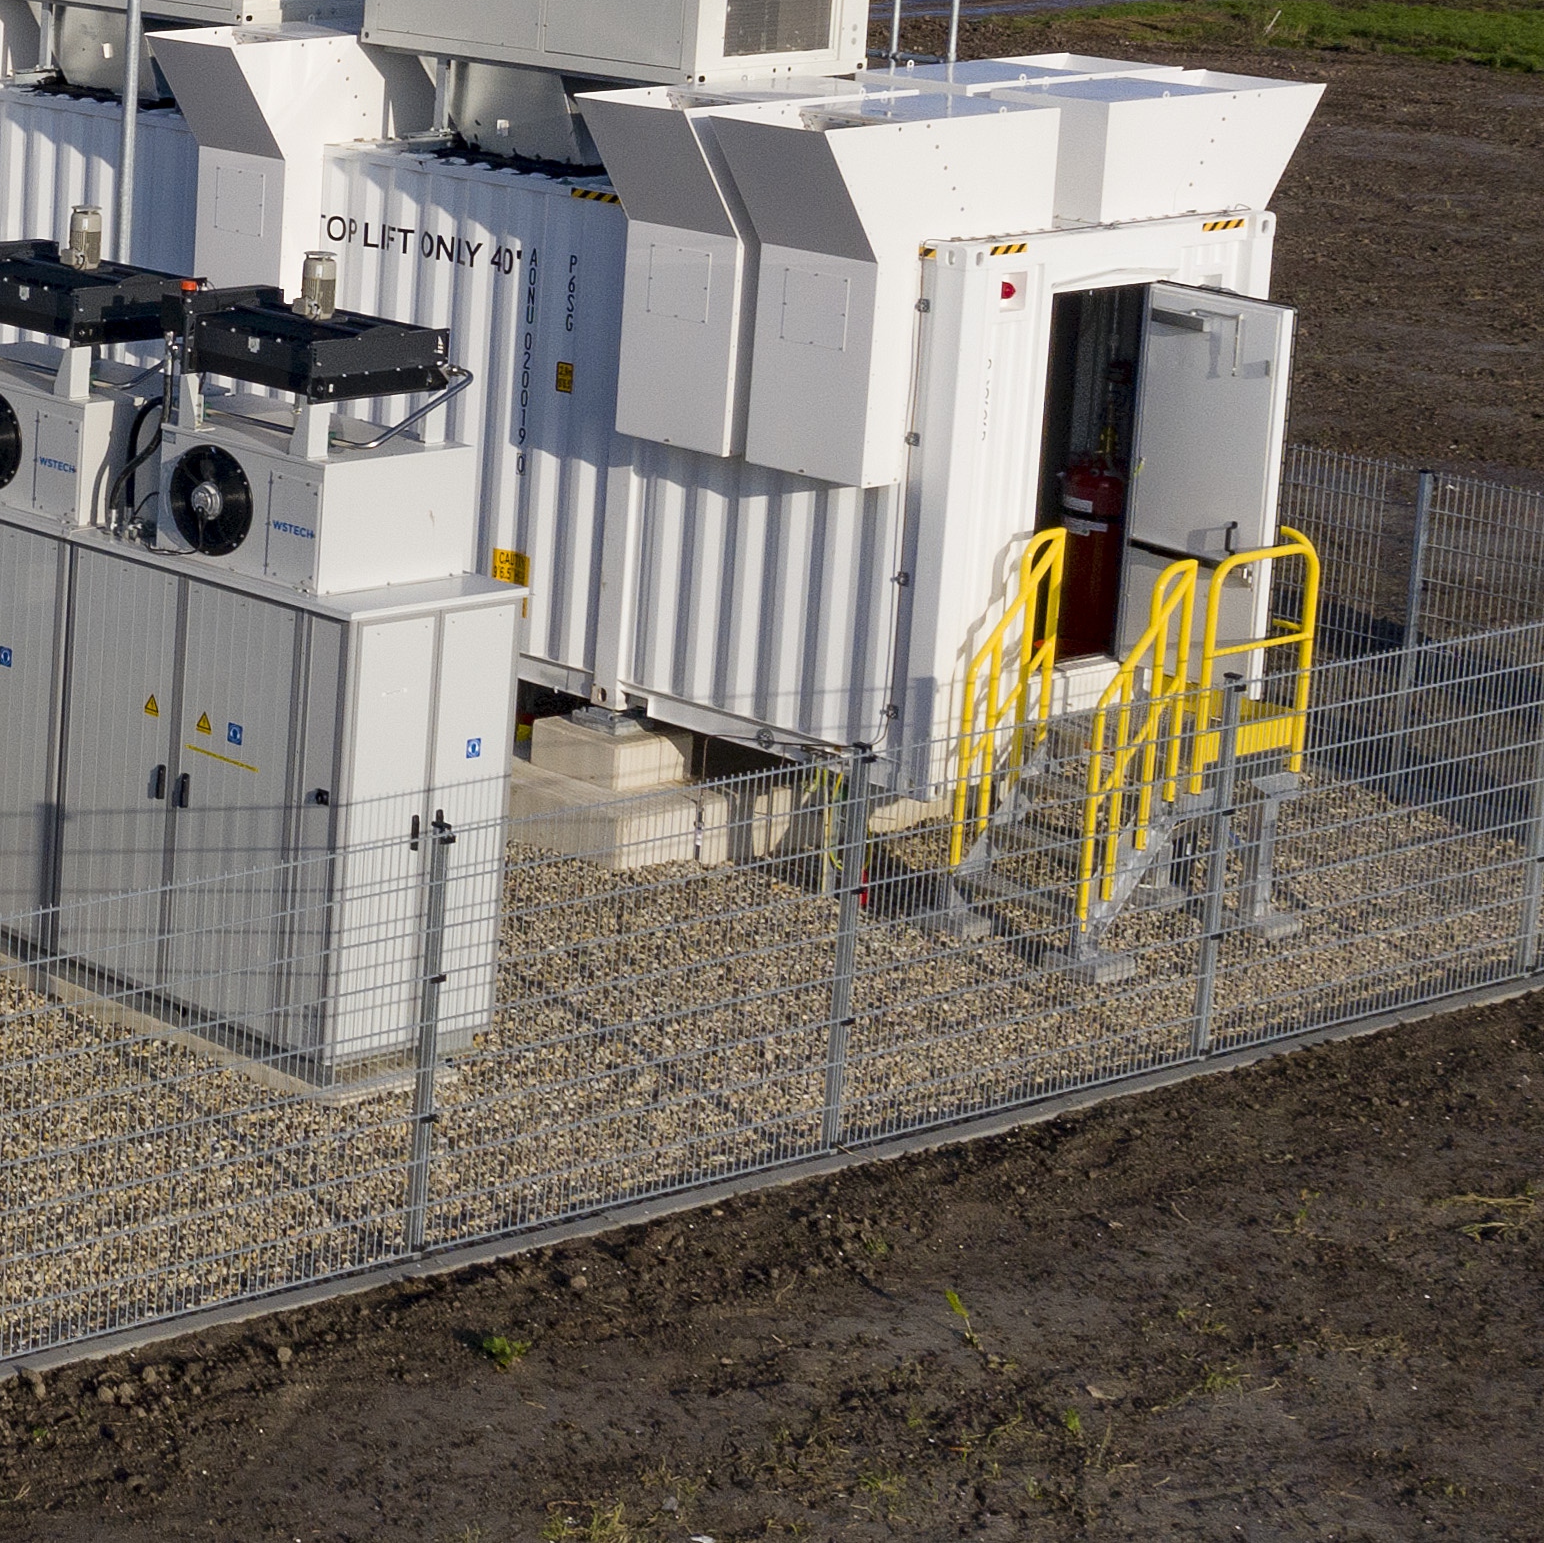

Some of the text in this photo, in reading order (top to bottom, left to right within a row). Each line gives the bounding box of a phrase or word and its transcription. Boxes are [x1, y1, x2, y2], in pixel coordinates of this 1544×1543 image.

[320, 214, 357, 243] OP
[363, 222, 415, 255] LIFT
[421, 230, 483, 268] ONLY
[39, 456, 76, 474] WSTECH
[271, 519, 315, 539] WSTECH
